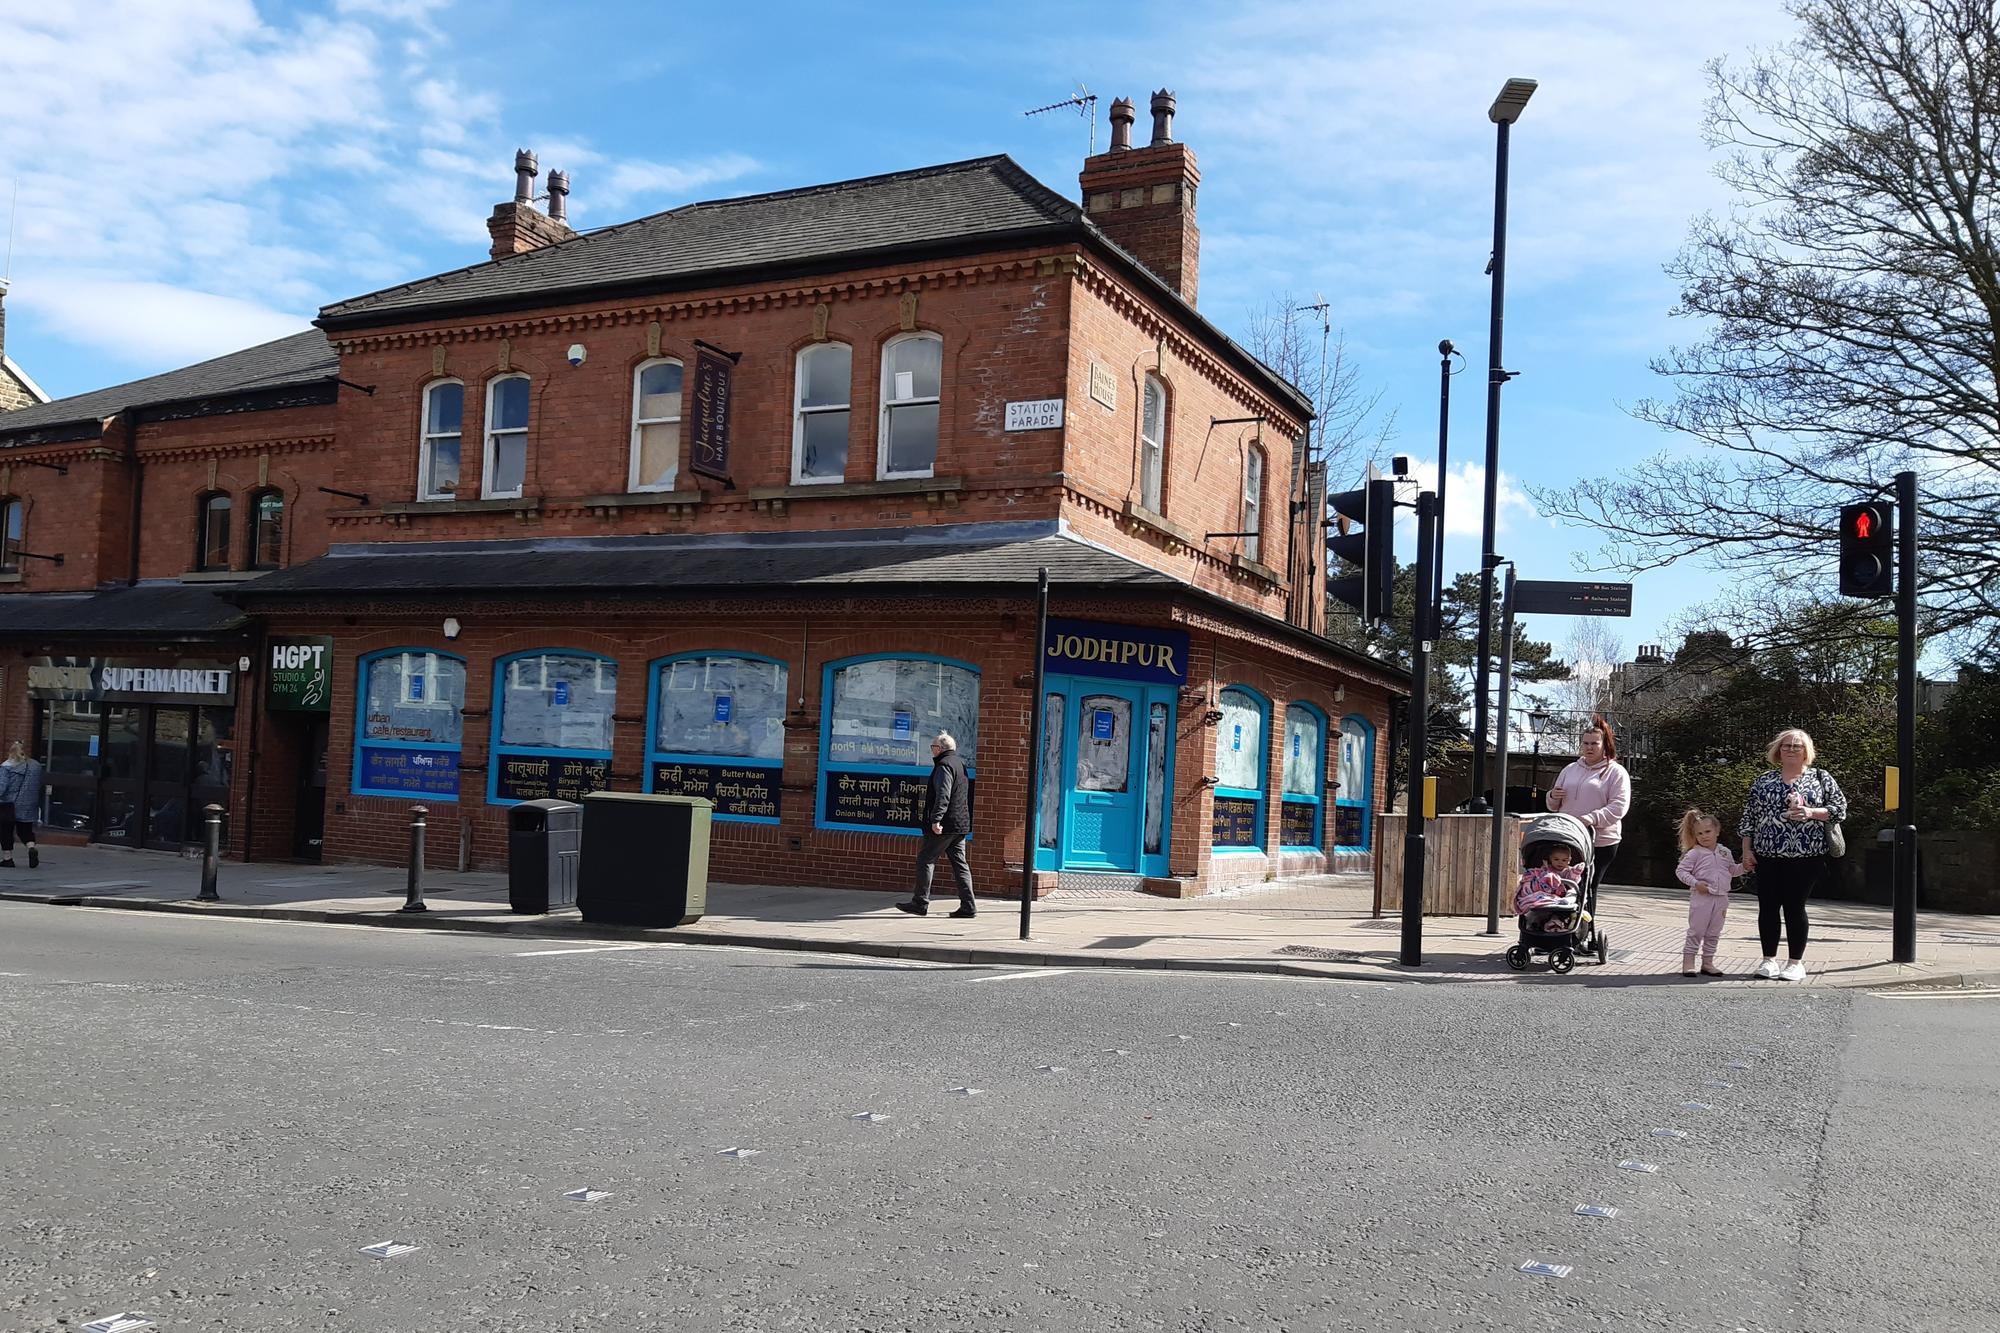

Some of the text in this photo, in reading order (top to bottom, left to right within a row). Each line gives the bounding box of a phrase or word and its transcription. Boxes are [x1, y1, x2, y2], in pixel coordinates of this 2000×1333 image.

[1094, 366, 1115, 390] BAINES
[1093, 381, 1114, 405] HOUSE
[1010, 402, 1059, 416] STATION
[716, 371, 726, 462] HAIR BOUTIQUE
[1011, 414, 1055, 428] PARADE
[272, 645, 325, 670] HGPT
[1047, 634, 1182, 676] JODHPUR
[101, 667, 232, 694] SUPERMARKET
[273, 672, 306, 682] STUDIO &
[272, 683, 298, 693] GYM 24
[368, 712, 390, 723] urban
[558, 777, 581, 785] Biryani
[722, 769, 765, 779] Butter Naan
[859, 778, 891, 793] सागरी
[882, 796, 899, 804] Chat
[857, 810, 875, 819] Bhaji
